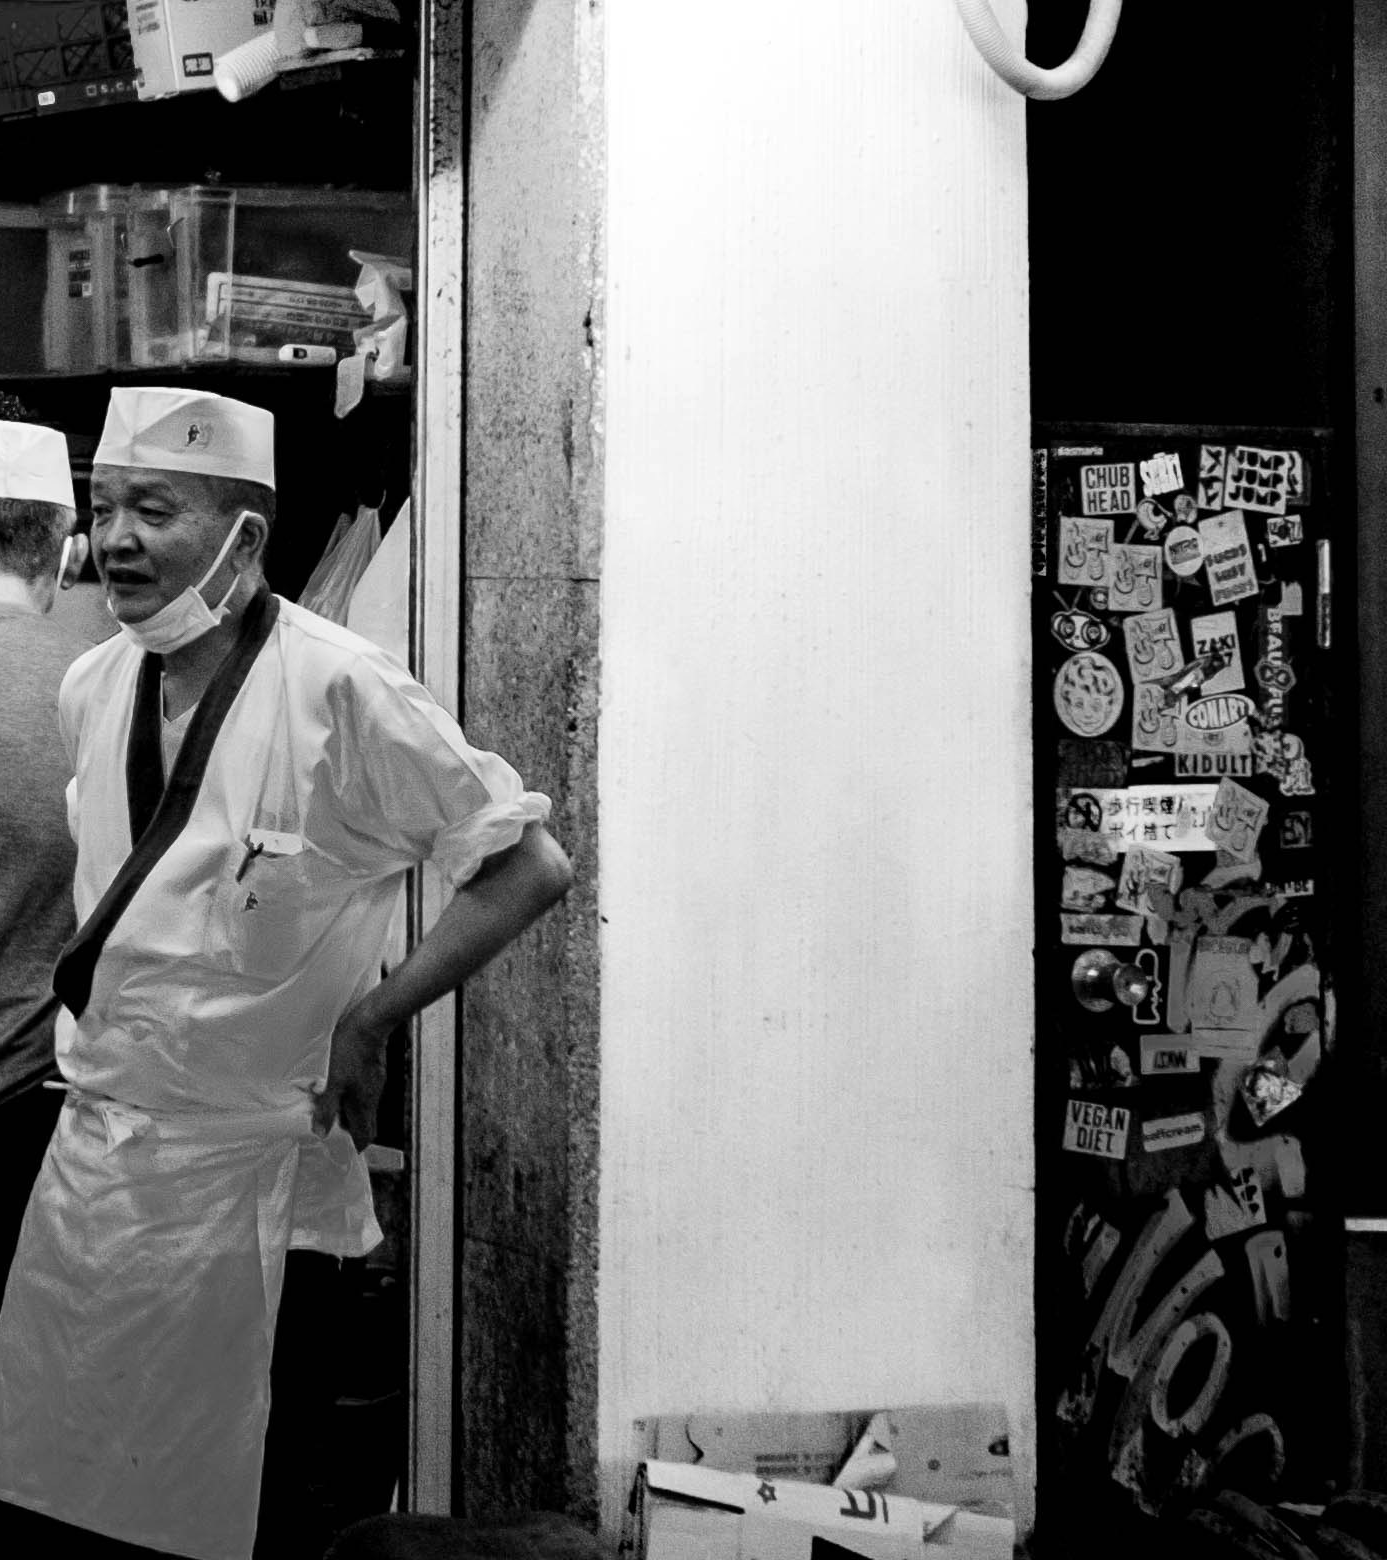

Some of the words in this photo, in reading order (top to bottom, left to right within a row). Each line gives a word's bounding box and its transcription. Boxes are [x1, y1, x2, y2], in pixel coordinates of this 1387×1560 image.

[1085, 465, 1131, 489] CHUB
[1231, 468, 1284, 490] JUMP
[1086, 489, 1131, 514] HEAD
[1228, 485, 1282, 507] JUMP
[1178, 753, 1248, 775] KIDULT
[1071, 1101, 1126, 1131] VEGAN
[1077, 1126, 1115, 1153] DIET
